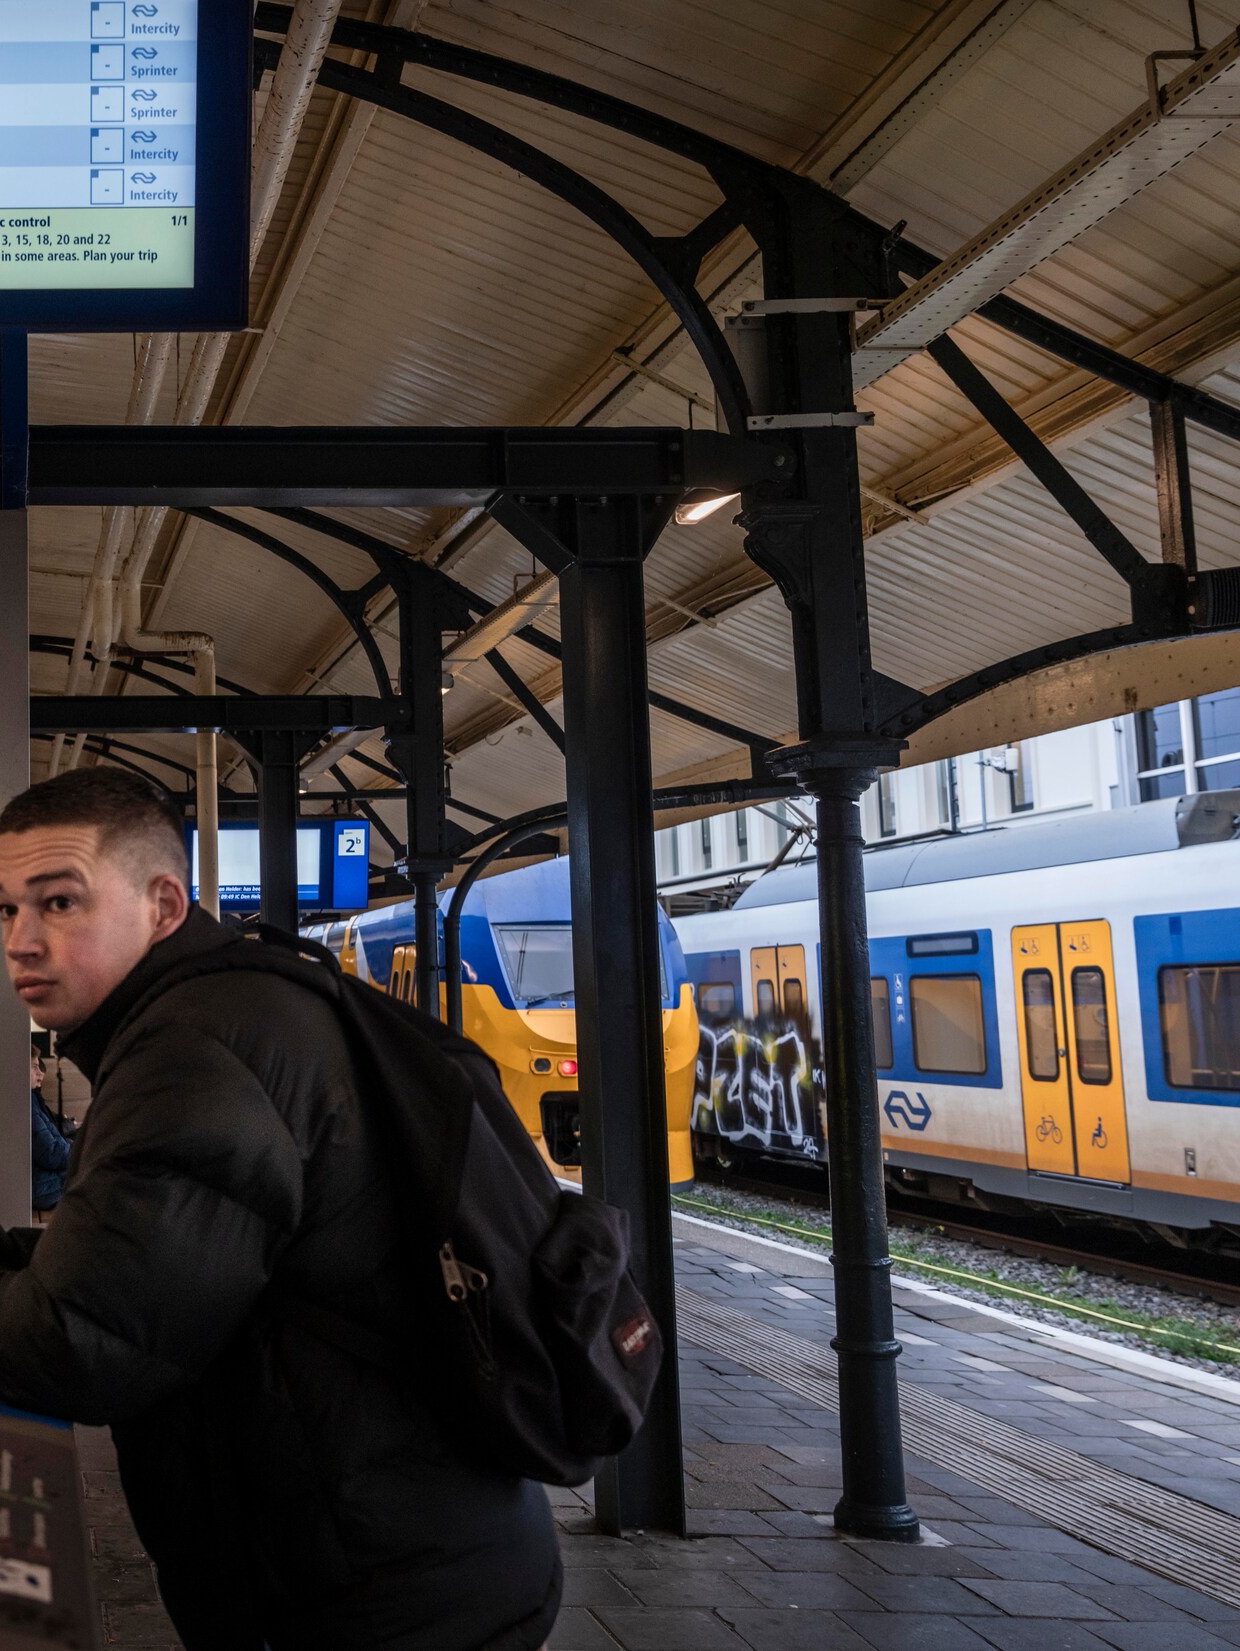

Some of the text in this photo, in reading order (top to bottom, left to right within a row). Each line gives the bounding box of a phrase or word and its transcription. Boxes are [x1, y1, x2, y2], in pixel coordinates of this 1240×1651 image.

[132, 23, 180, 36] Intercity
[131, 65, 177, 78] Sprinter
[131, 107, 177, 120] Sprinter
[131, 148, 178, 161] Intercity
[131, 189, 178, 202] Intercity
[9, 216, 50, 227] control
[172, 216, 187, 226] 1/1
[16, 235, 31, 246] 15,
[37, 235, 52, 246] 18,
[57, 234, 70, 245] 20
[74, 234, 93, 244] and
[98, 234, 110, 244] 22
[2, 251, 11, 261] in
[15, 253, 43, 261] some
[48, 253, 79, 261] areas.
[84, 250, 106, 261] Plan
[110, 253, 134, 263] your
[139, 250, 157, 263] trip
